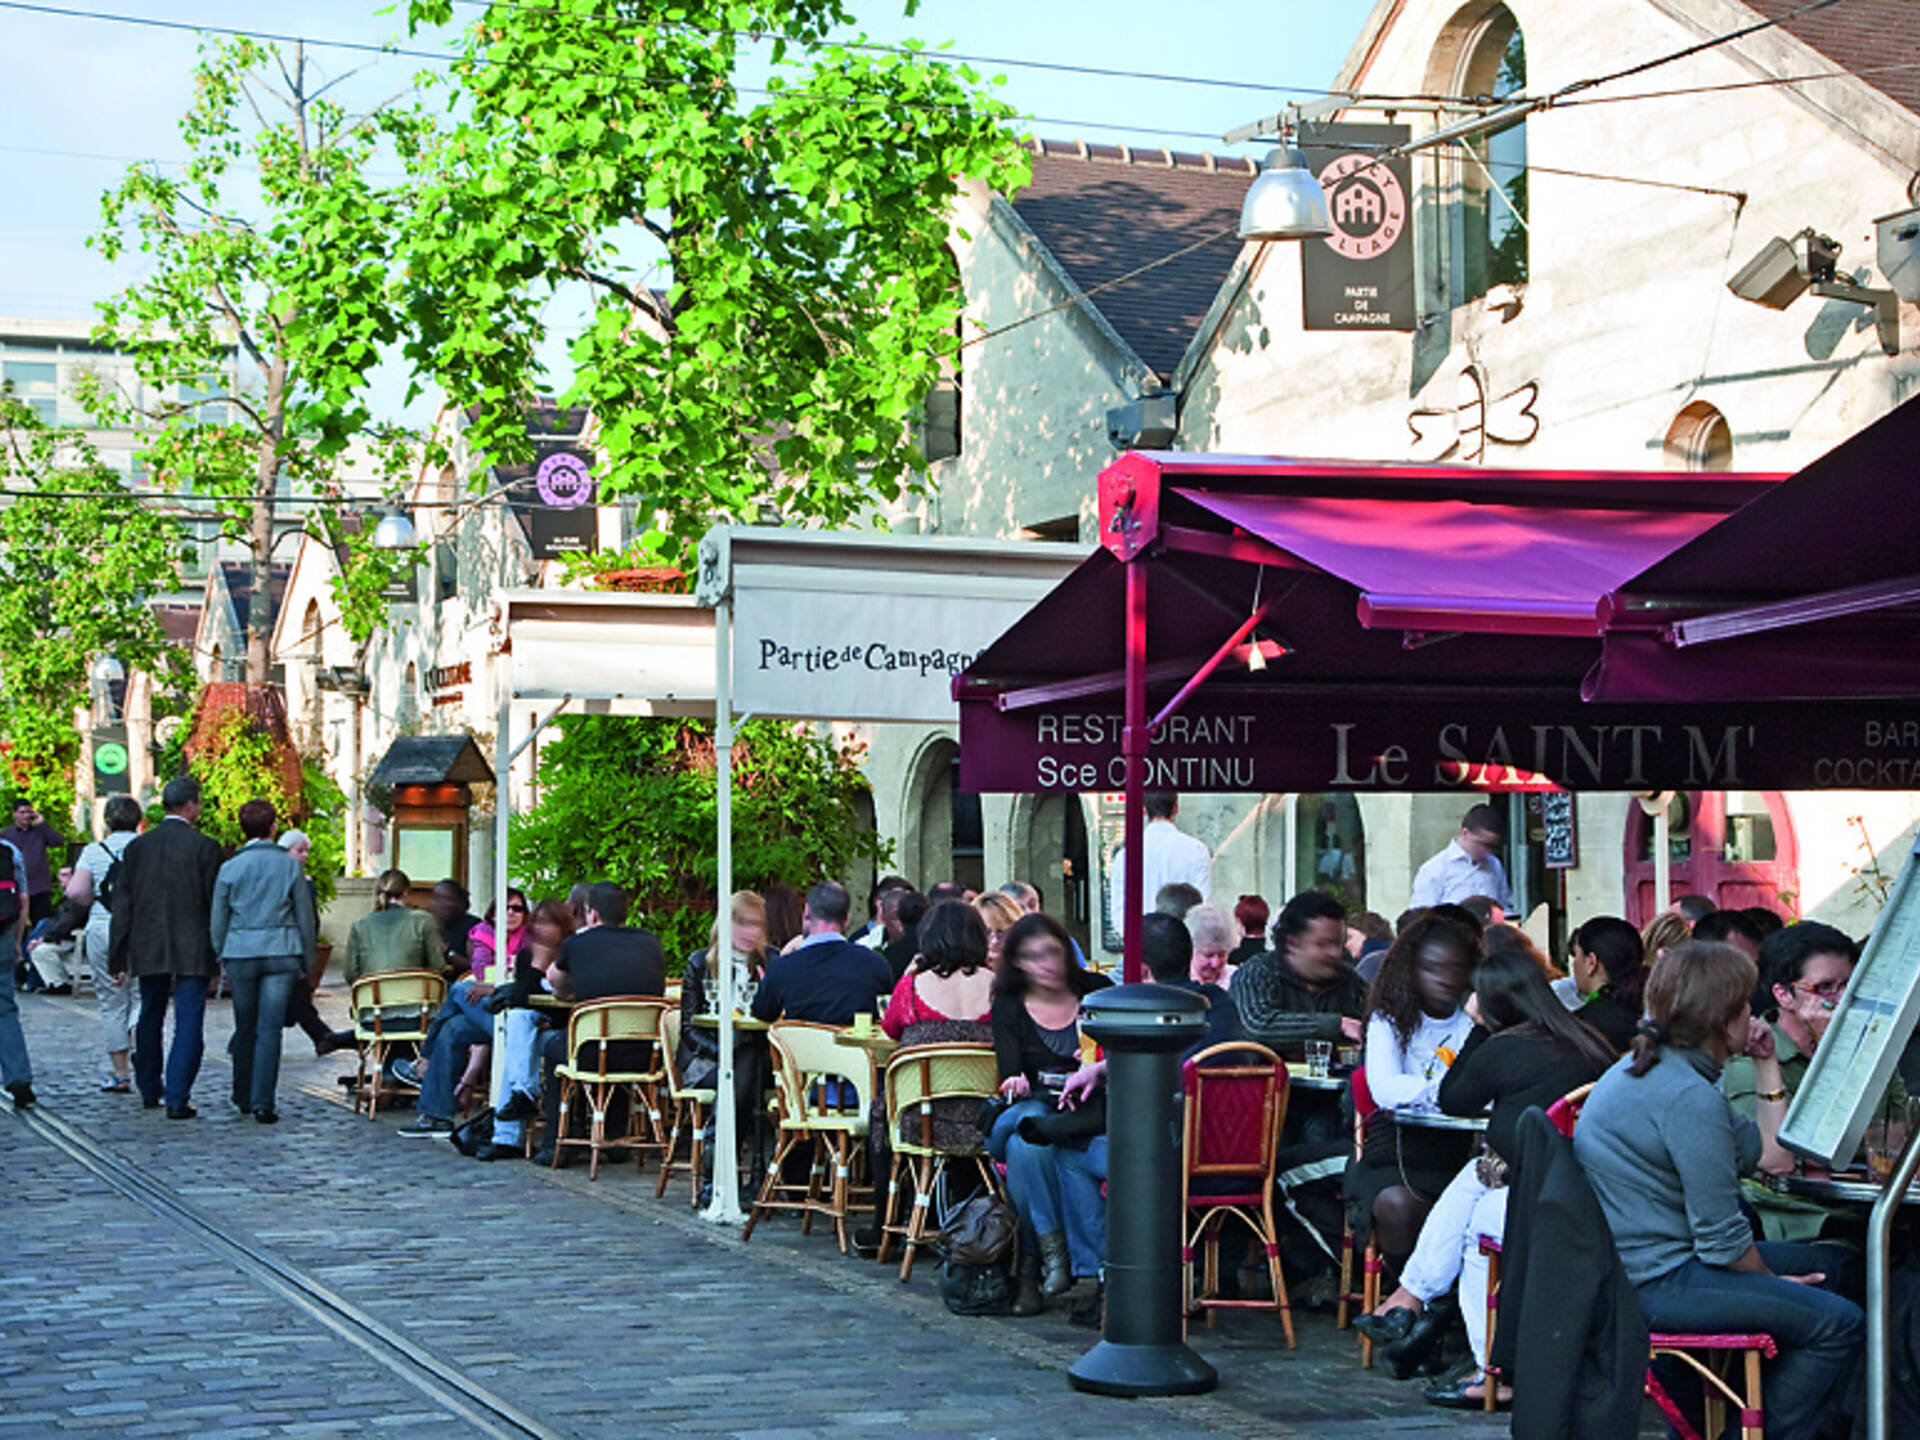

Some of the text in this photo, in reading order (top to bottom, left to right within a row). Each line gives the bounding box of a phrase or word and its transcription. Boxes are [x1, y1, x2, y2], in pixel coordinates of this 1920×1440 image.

[758, 638, 840, 673] Partie
[840, 646, 863, 663] de
[1037, 714, 1256, 745] RESTURANT
[1865, 720, 1920, 748] BAR
[1328, 722, 1410, 786] Le
[1433, 722, 1663, 786] SAINT
[1037, 755, 1098, 787] Sce
